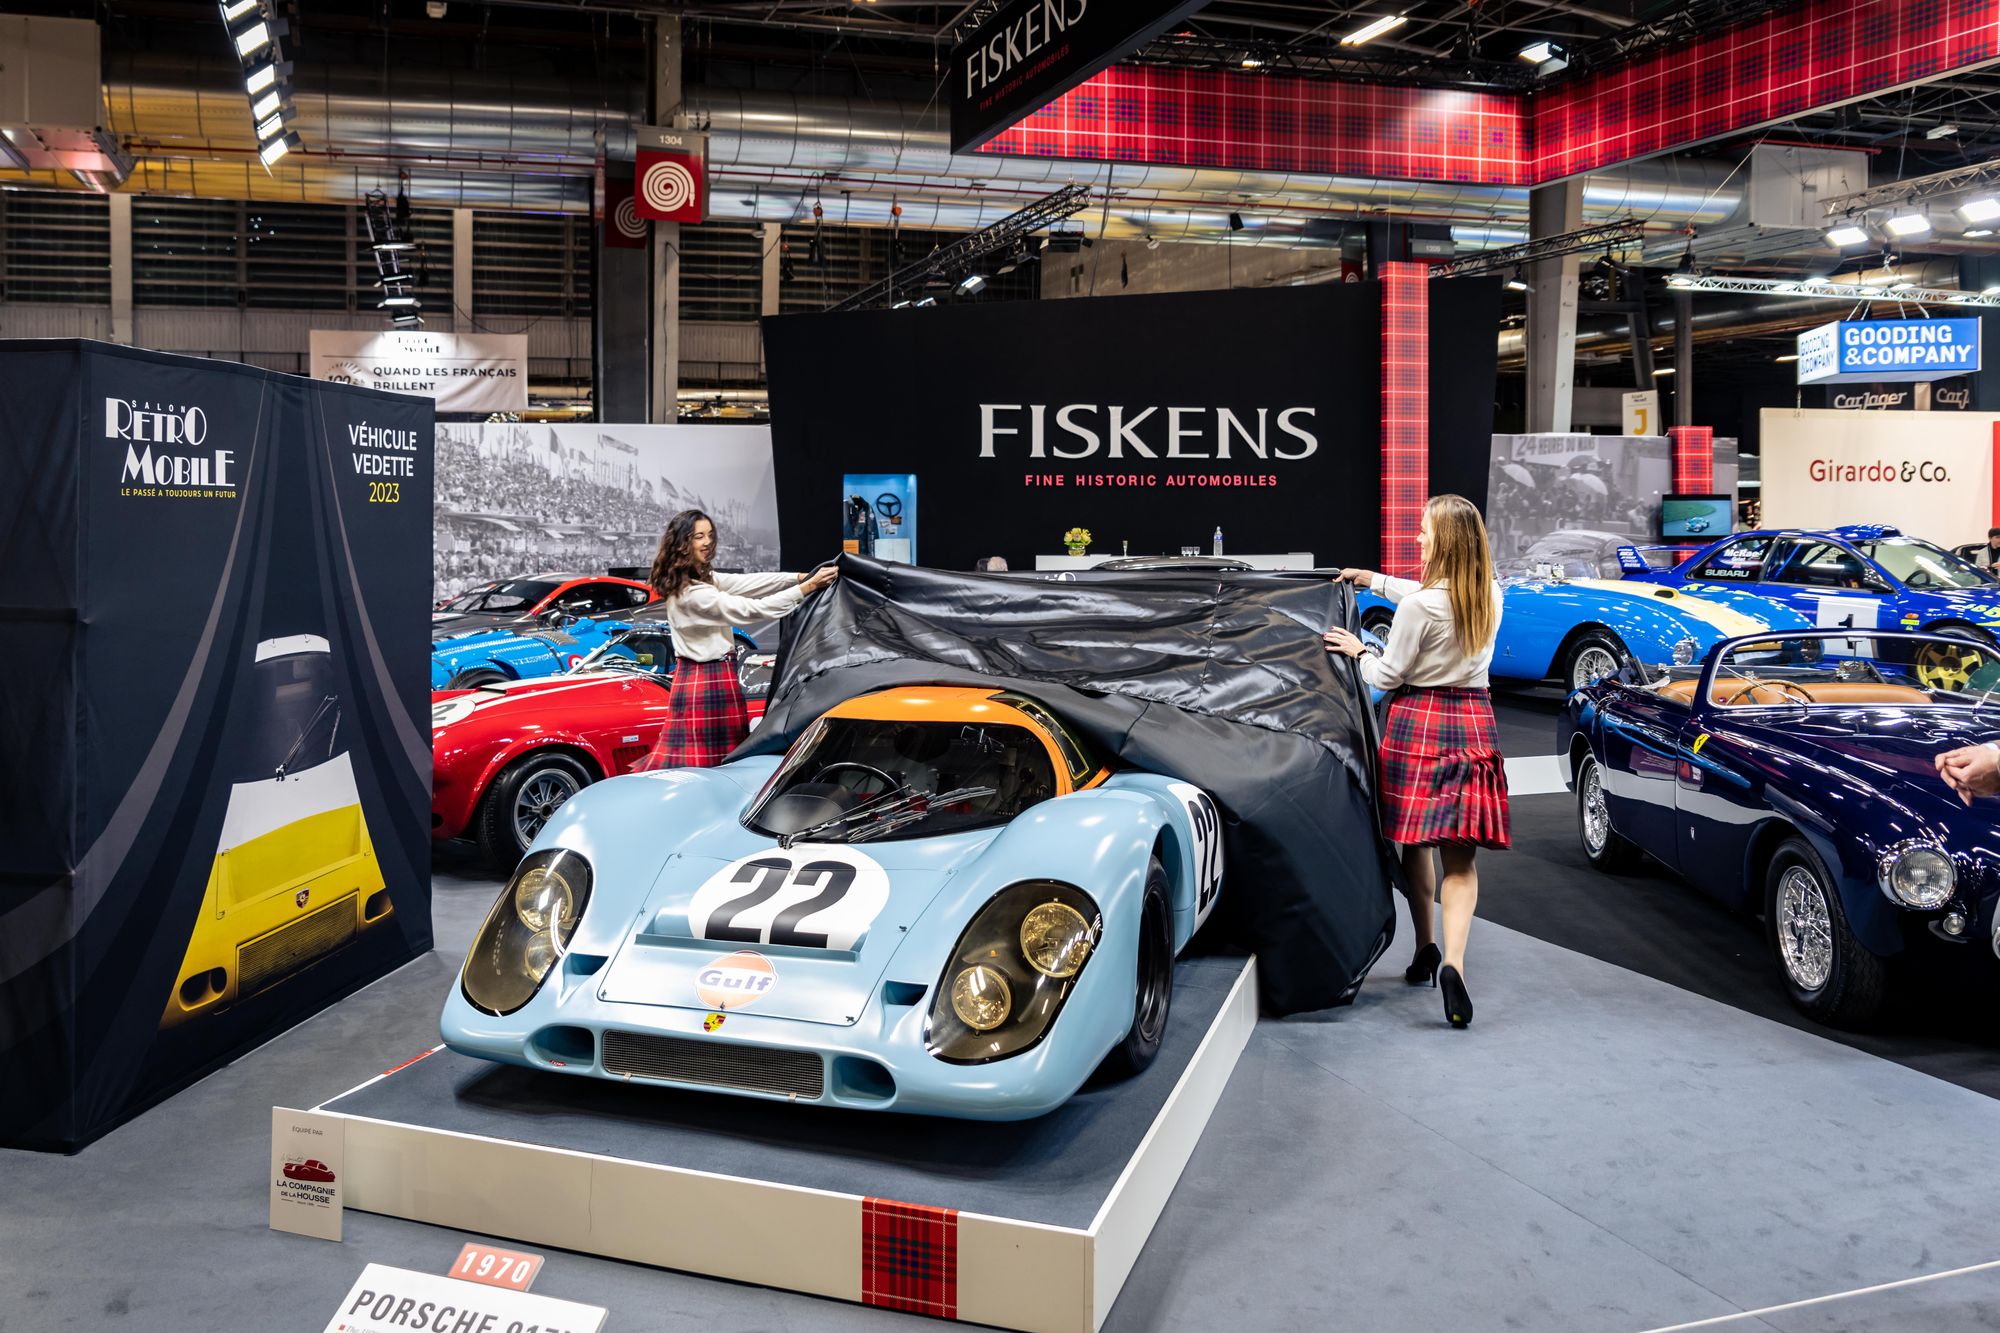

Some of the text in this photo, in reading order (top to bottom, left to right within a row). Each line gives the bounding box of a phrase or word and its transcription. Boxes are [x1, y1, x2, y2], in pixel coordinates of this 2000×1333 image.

[659, 135, 683, 146] 1304
[1845, 325, 1953, 346] GOODING
[1844, 345, 1972, 366] &COMPANY
[373, 366, 517, 380] QUAND LES FRANÇAIS
[373, 381, 435, 391] BRILLENT
[131, 399, 186, 413] SALON
[105, 397, 207, 446] RETRO
[979, 403, 1318, 460] FISKENS
[1633, 408, 1648, 436] J
[348, 420, 417, 451] VÉHICULE
[121, 442, 235, 487] MOBILE
[352, 452, 414, 477] VEDETTE
[1809, 459, 1897, 482] Girardo
[369, 481, 400, 502] 2023
[1025, 475, 1278, 487] FINE HISTORIC AUTOMOBILES
[121, 487, 237, 499] LE PASSÉ A TOUJOURS UN FUTUR
[1704, 568, 1750, 577] SUBARU
[1188, 793, 1220, 916] 22
[704, 857, 857, 949] 22
[699, 969, 773, 991] Gulf
[276, 1179, 336, 1196] LA COMPAGNIE
[297, 1191, 330, 1205] HOUSSE
[461, 1251, 532, 1283] 1970
[348, 1289, 498, 1333] PORSCHE
